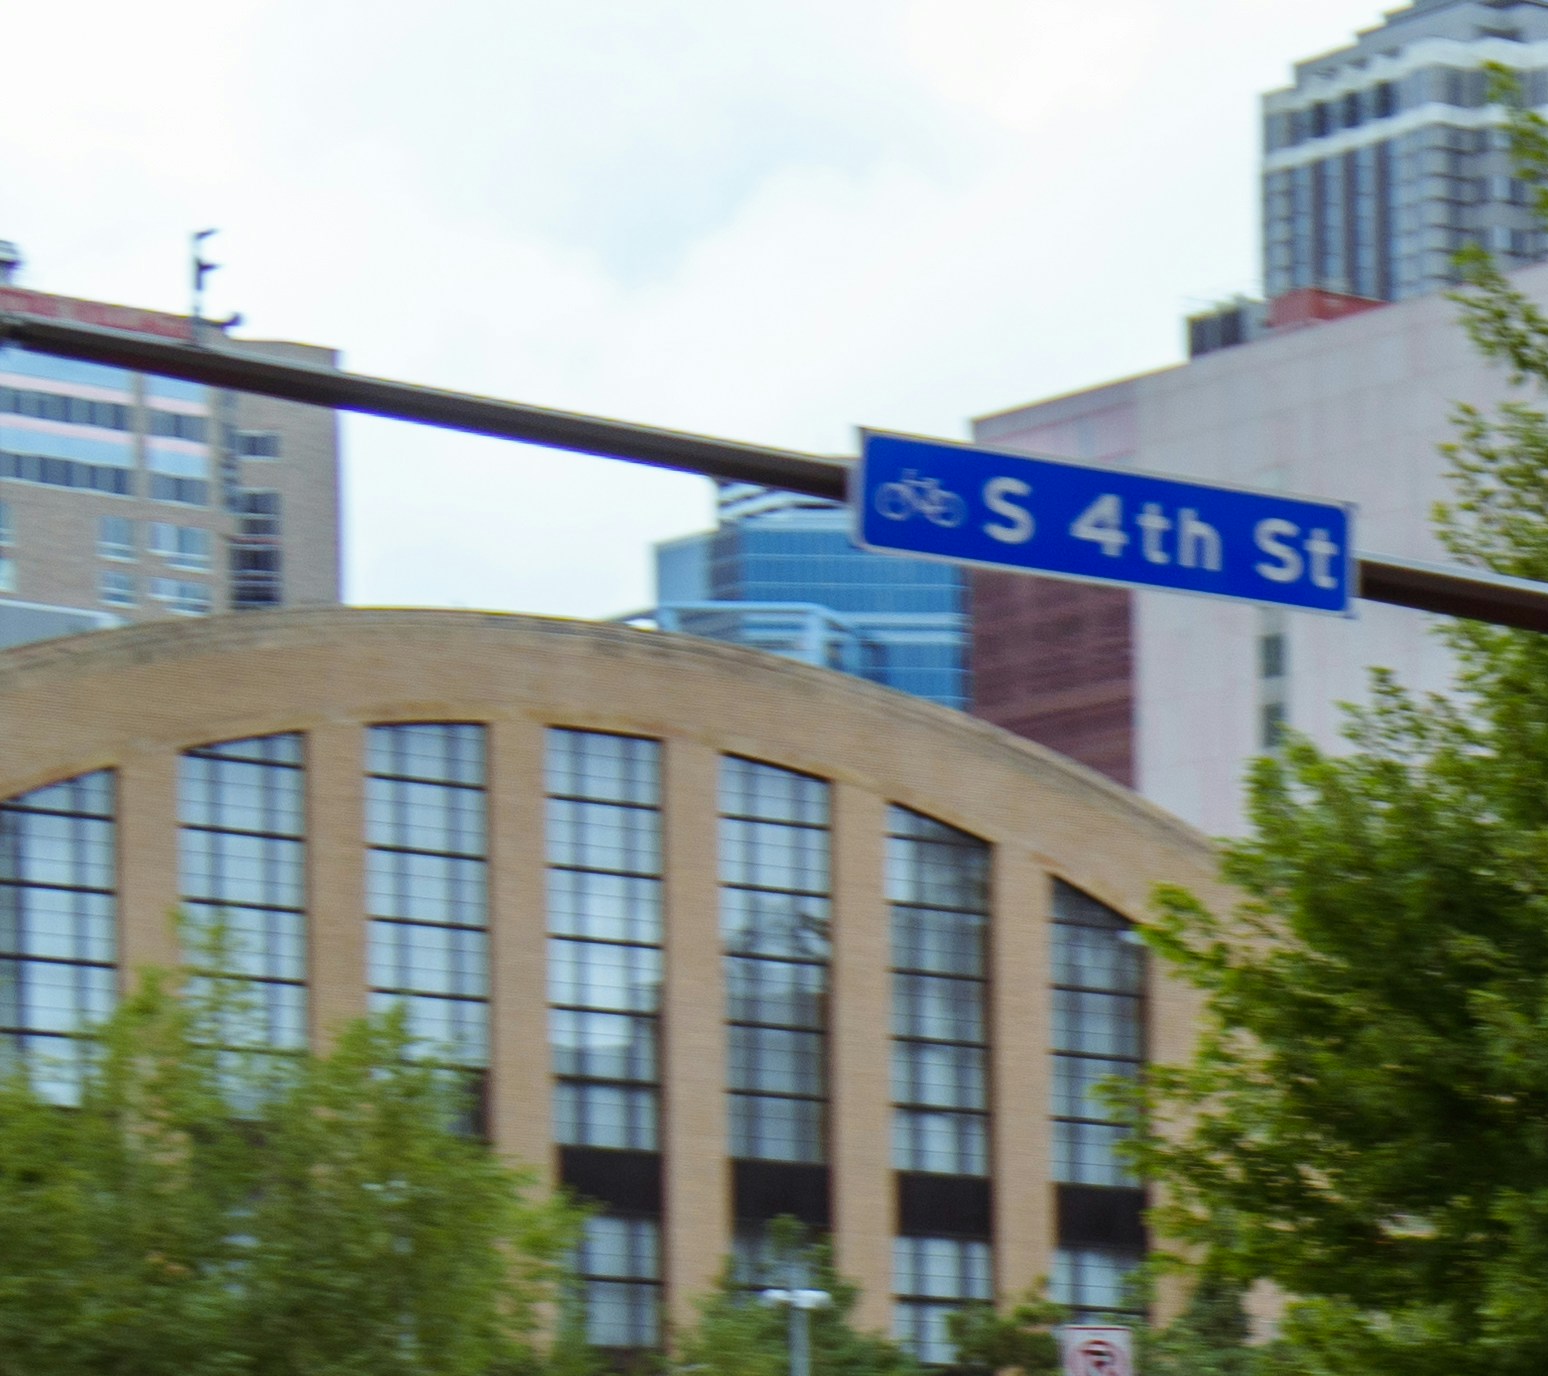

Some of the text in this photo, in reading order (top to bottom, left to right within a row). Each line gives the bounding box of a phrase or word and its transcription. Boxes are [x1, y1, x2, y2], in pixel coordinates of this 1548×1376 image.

[981, 477, 1340, 591] S 4th St
